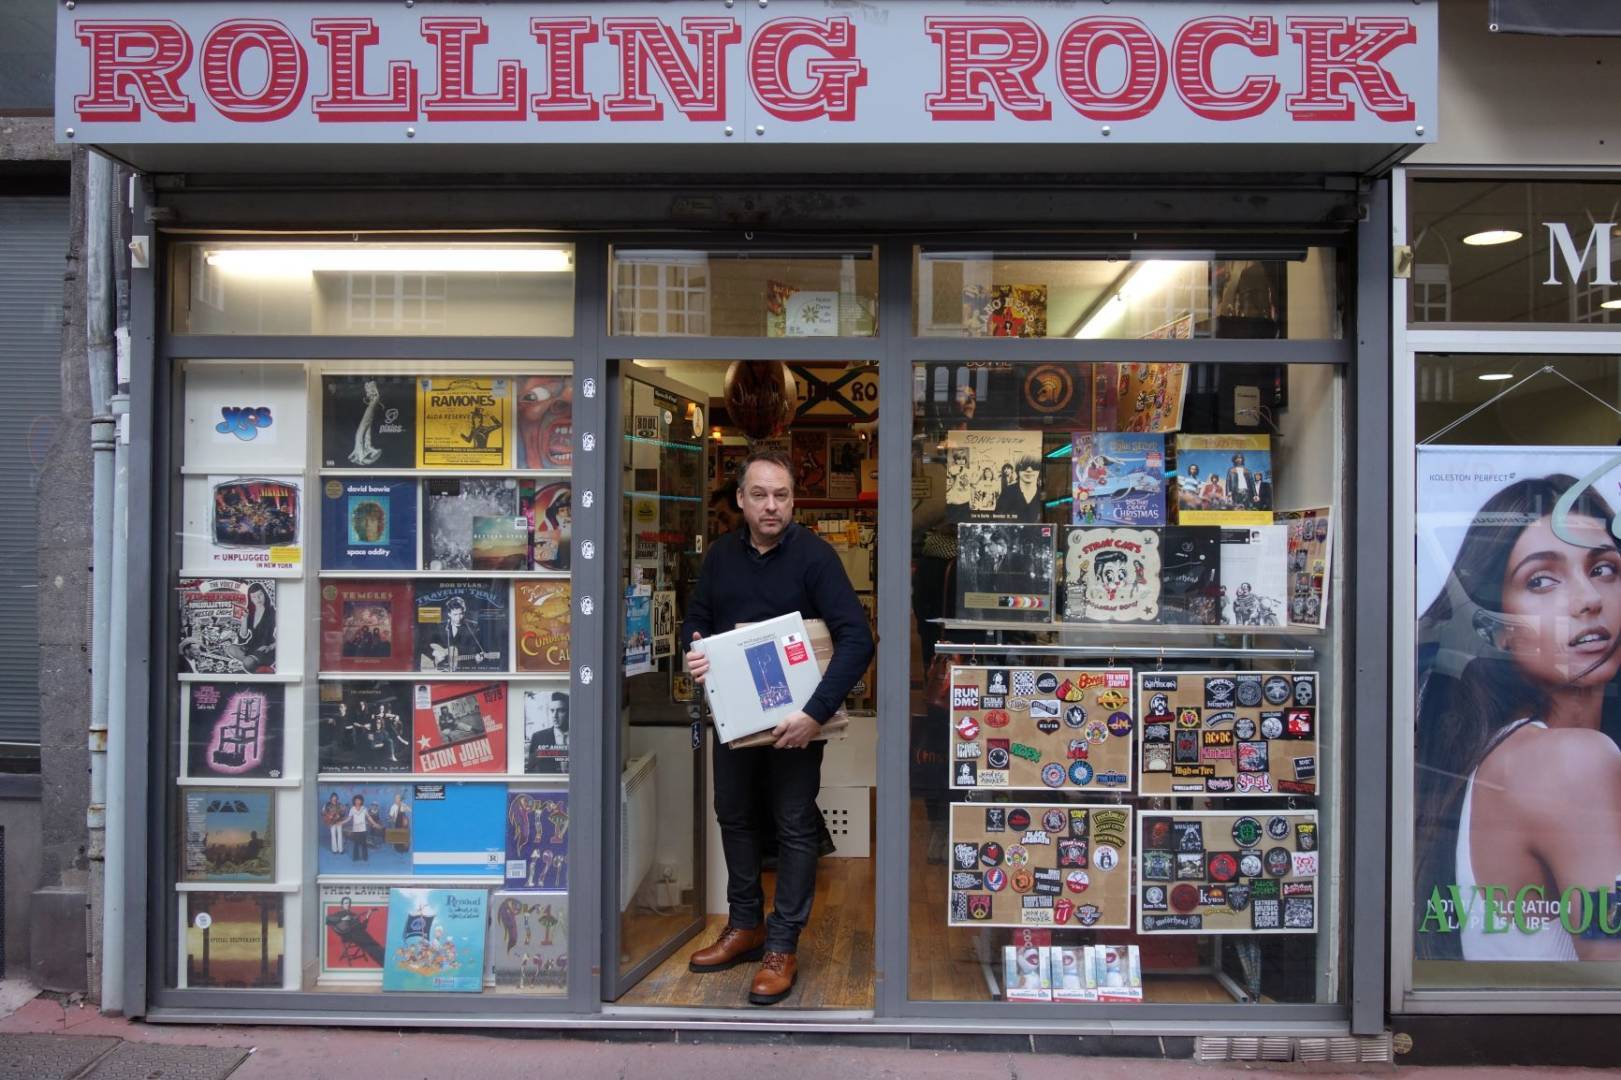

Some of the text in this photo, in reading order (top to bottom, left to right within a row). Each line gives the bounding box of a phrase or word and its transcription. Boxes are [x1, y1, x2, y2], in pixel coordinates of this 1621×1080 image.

[74, 15, 1417, 123] ROLLING ROCK
[1542, 223, 1618, 286] M
[431, 395, 496, 408] RAMONES
[966, 434, 993, 445] SONIC
[1429, 474, 1509, 482] KOLESTON PERFECT
[347, 485, 391, 493] david bowie
[1112, 507, 1159, 519] CHRISTMAS
[1082, 538, 1142, 554] STRAY CATS
[222, 554, 270, 562] UNPLUGGED
[347, 548, 391, 557] space oddity
[342, 591, 393, 600] TEMPLES
[954, 687, 979, 698] RUN
[954, 698, 979, 707] DMC
[460, 738, 492, 764] JOHN
[420, 747, 457, 773] ELTON
[1175, 766, 1191, 776] High
[322, 886, 351, 895] THEO
[1199, 889, 1225, 904] kyuss
[1418, 884, 1545, 935] AVEC
